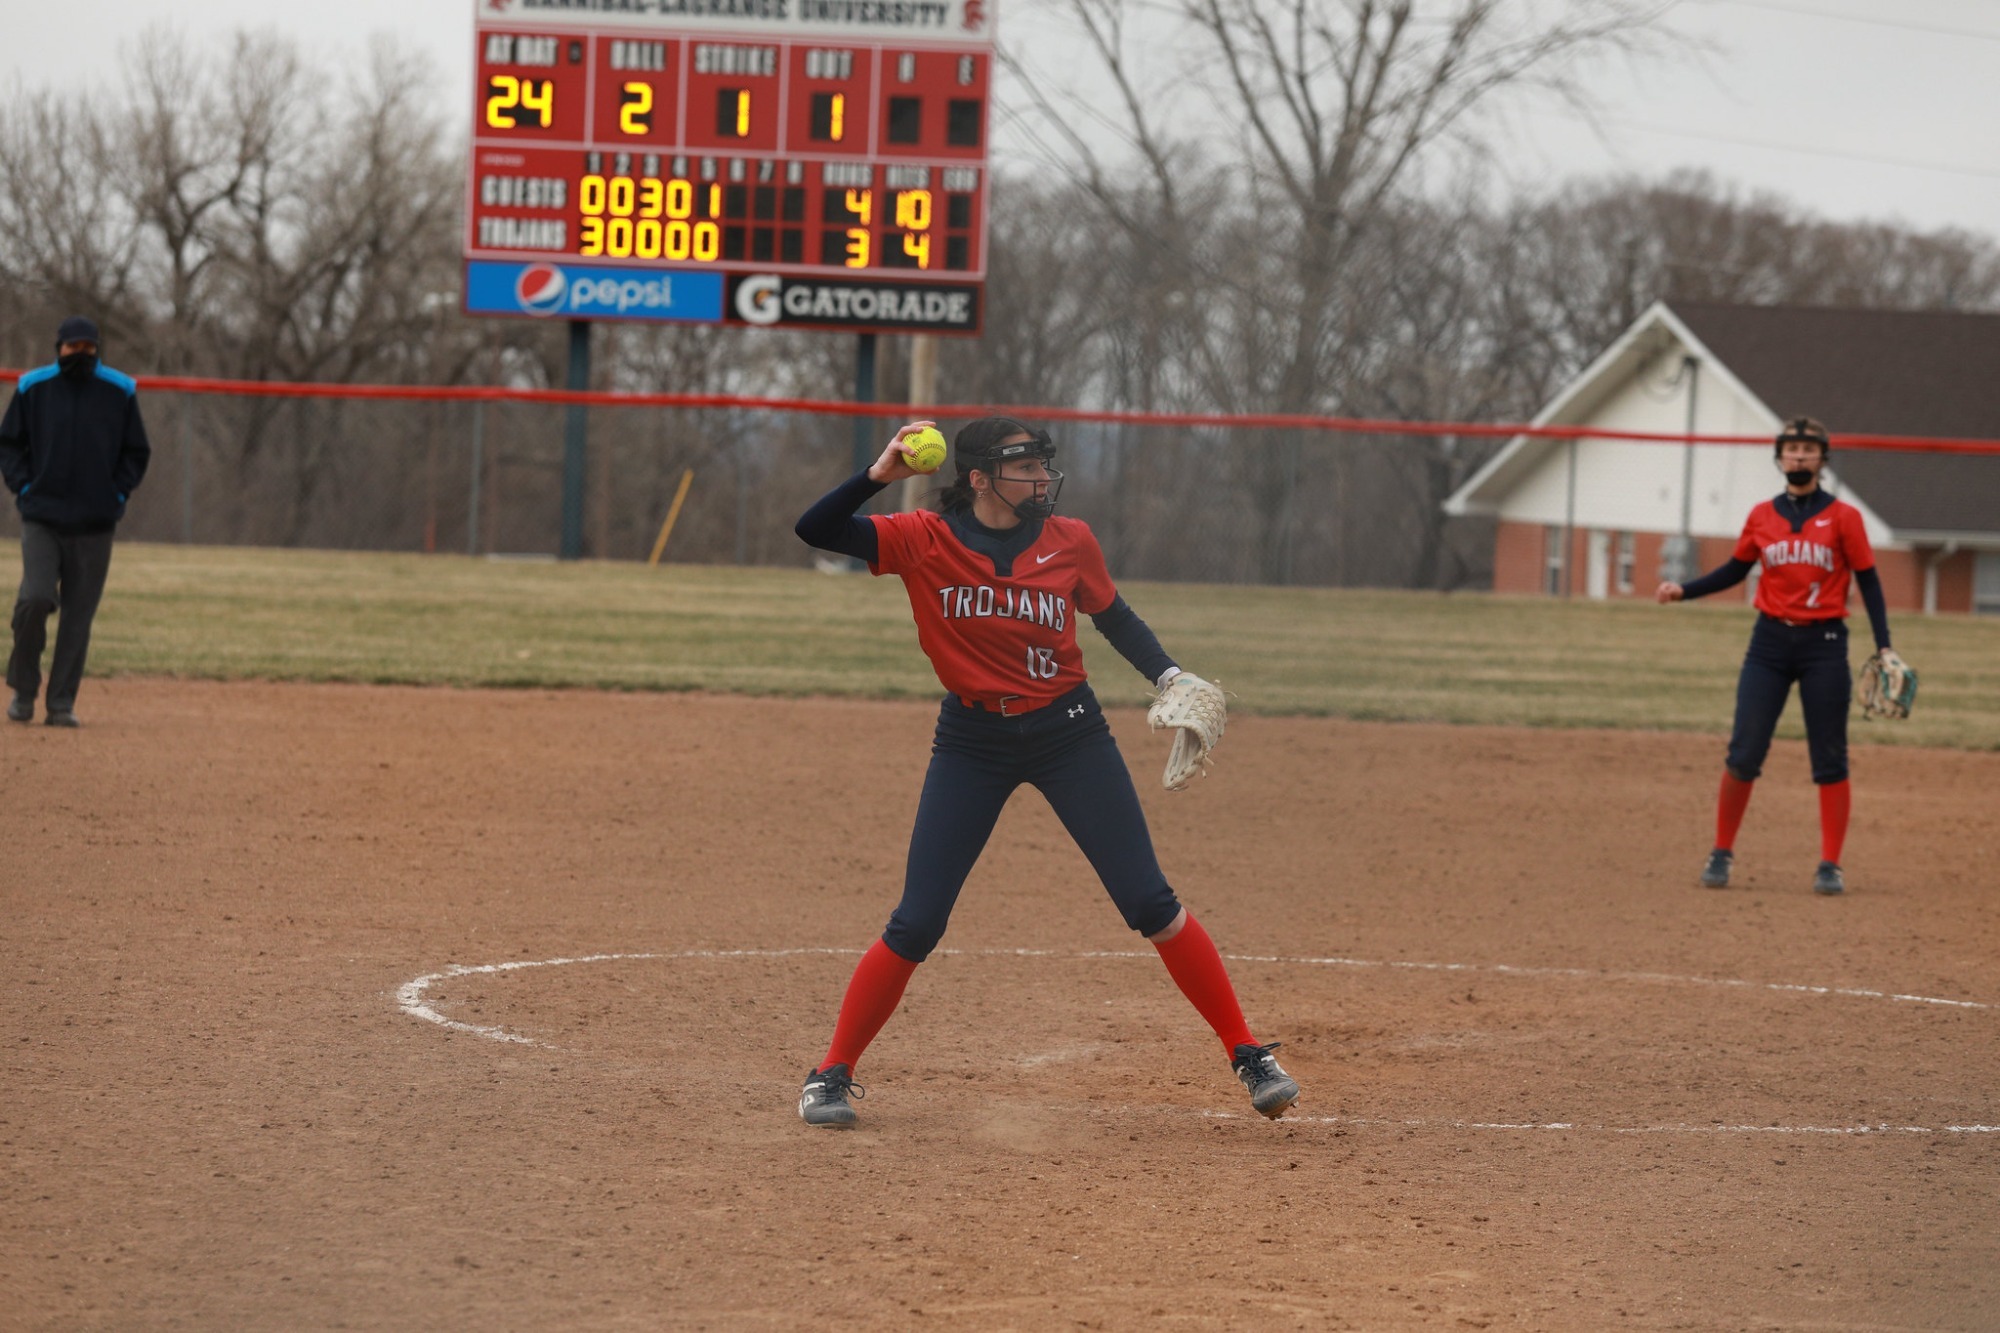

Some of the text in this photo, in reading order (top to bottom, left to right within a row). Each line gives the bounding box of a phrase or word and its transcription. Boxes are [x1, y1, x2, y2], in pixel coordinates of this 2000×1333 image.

[486, 75, 554, 128] 24
[620, 82, 653, 134] 2
[737, 90, 751, 136] 1
[830, 94, 844, 140] 1
[482, 175, 566, 210] GUESTS
[846, 190, 871, 225] 4
[897, 190, 931, 230] 10
[846, 229, 870, 268] 3
[904, 233, 930, 269] 4
[570, 276, 672, 311] pepsi
[784, 285, 970, 323] GATORADE
[1763, 540, 1833, 573] TROJANS
[939, 585, 1066, 633] TROJANS
